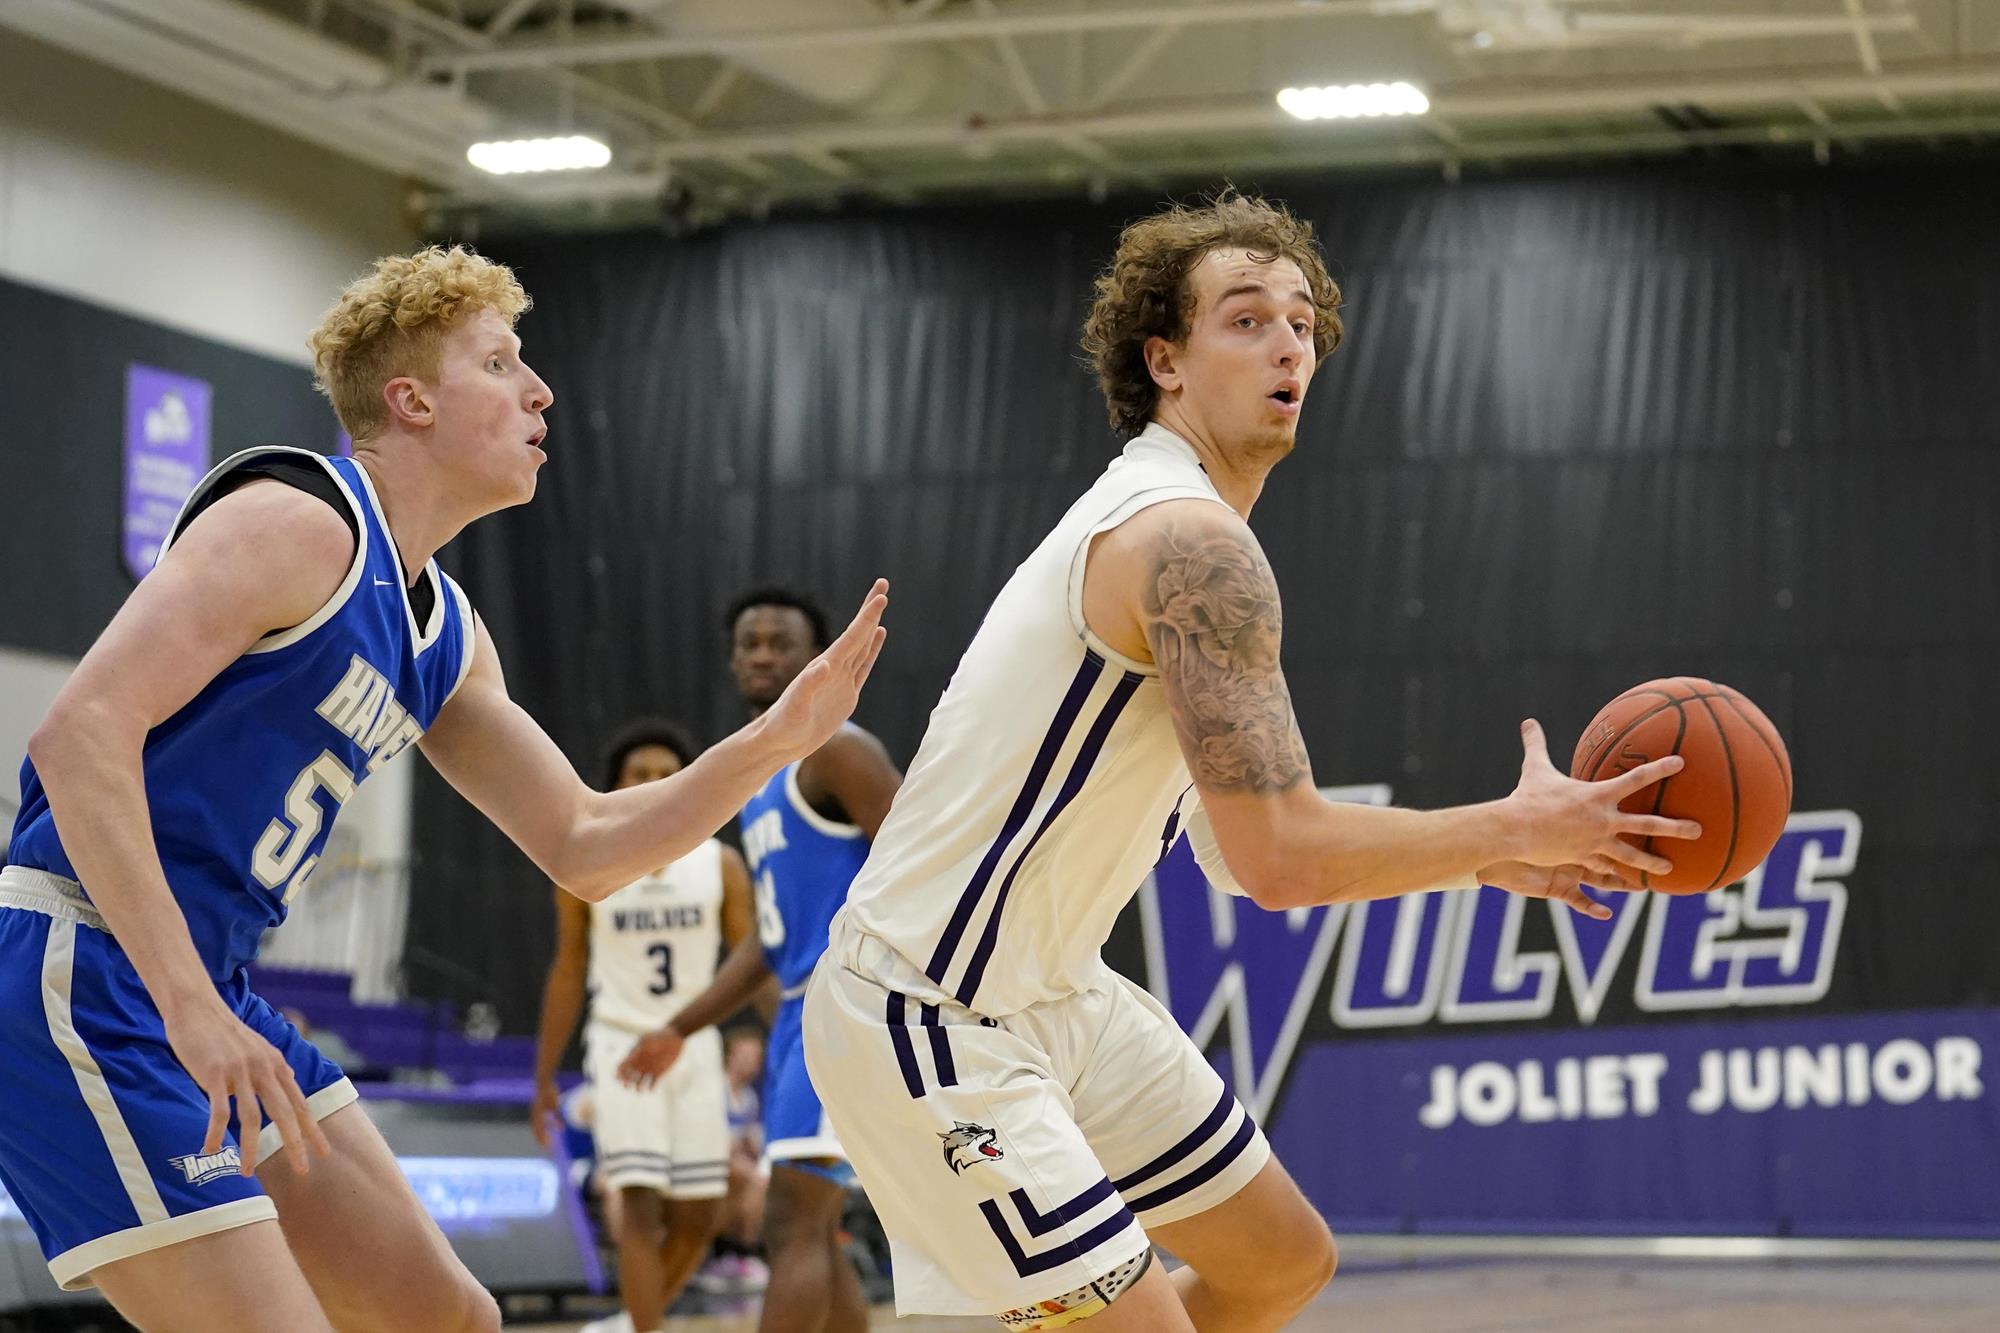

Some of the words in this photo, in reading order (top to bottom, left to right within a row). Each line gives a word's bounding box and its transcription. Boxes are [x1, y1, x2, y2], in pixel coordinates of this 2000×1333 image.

[251, 748, 359, 905] 5
[613, 904, 703, 932] WOLVES
[1136, 784, 1863, 1132] WOLVES
[646, 941, 674, 996] 3
[1418, 1053, 1668, 1129] JOLIET
[1687, 1036, 1984, 1115] JUNIOR
